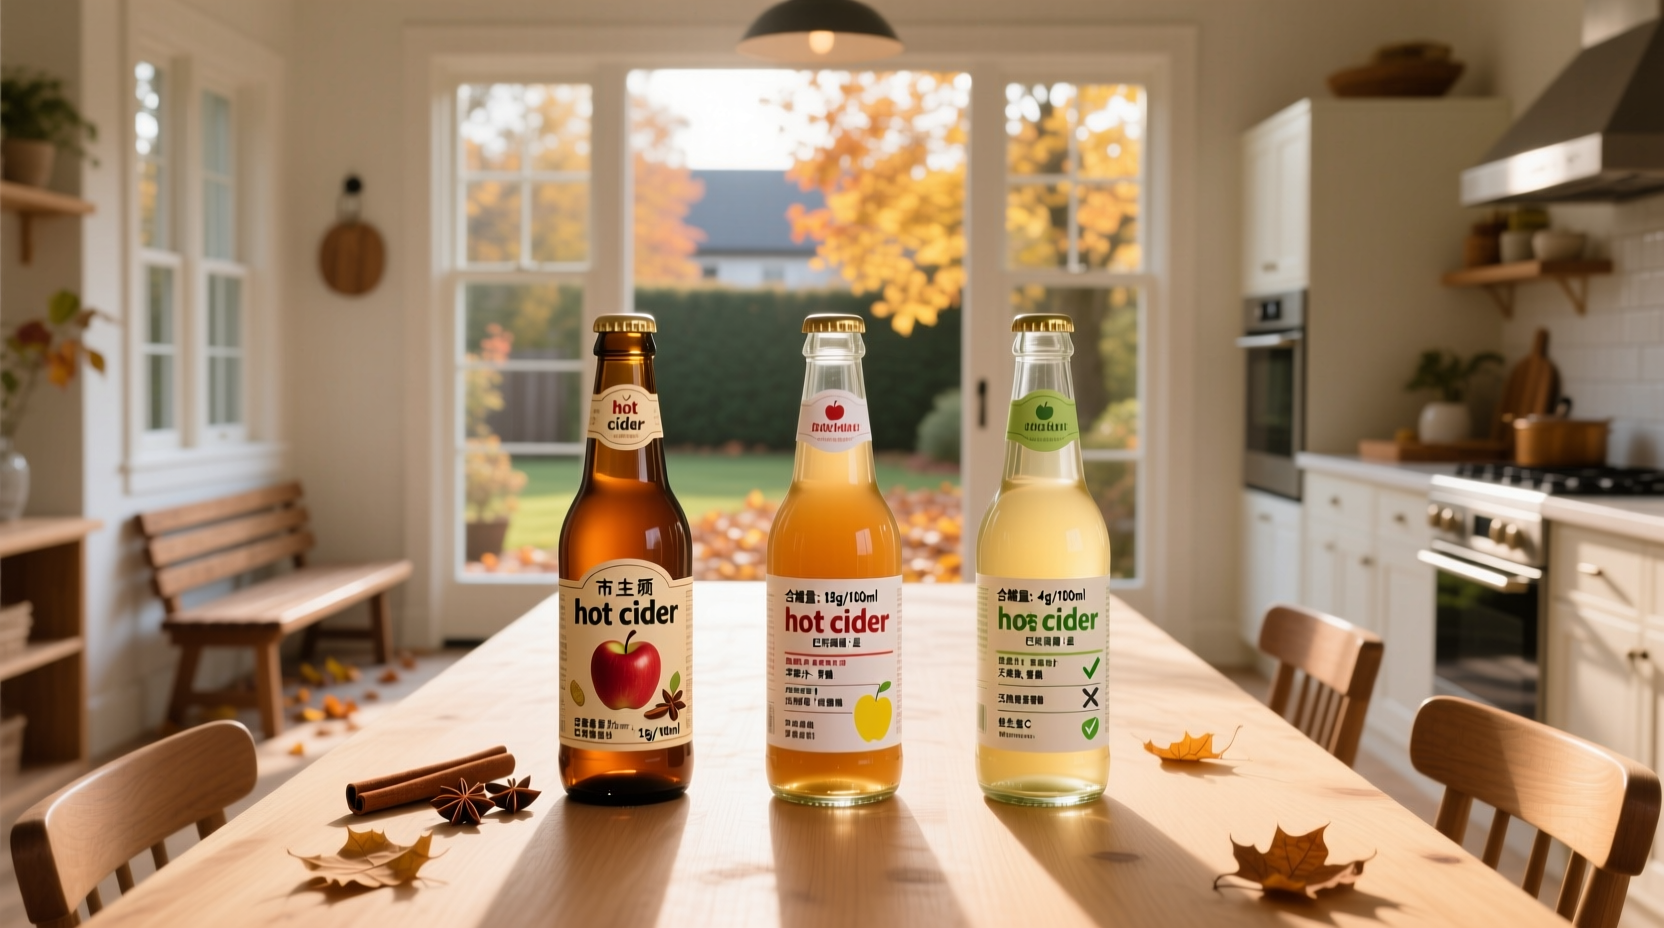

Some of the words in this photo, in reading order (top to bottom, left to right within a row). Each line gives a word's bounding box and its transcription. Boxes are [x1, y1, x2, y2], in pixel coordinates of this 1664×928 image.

[612, 399, 638, 415] hot
[574, 598, 613, 626] hot
[619, 599, 679, 626] cider
[785, 606, 825, 634] hot
[830, 607, 890, 634] cider
[1042, 606, 1099, 632] cider
